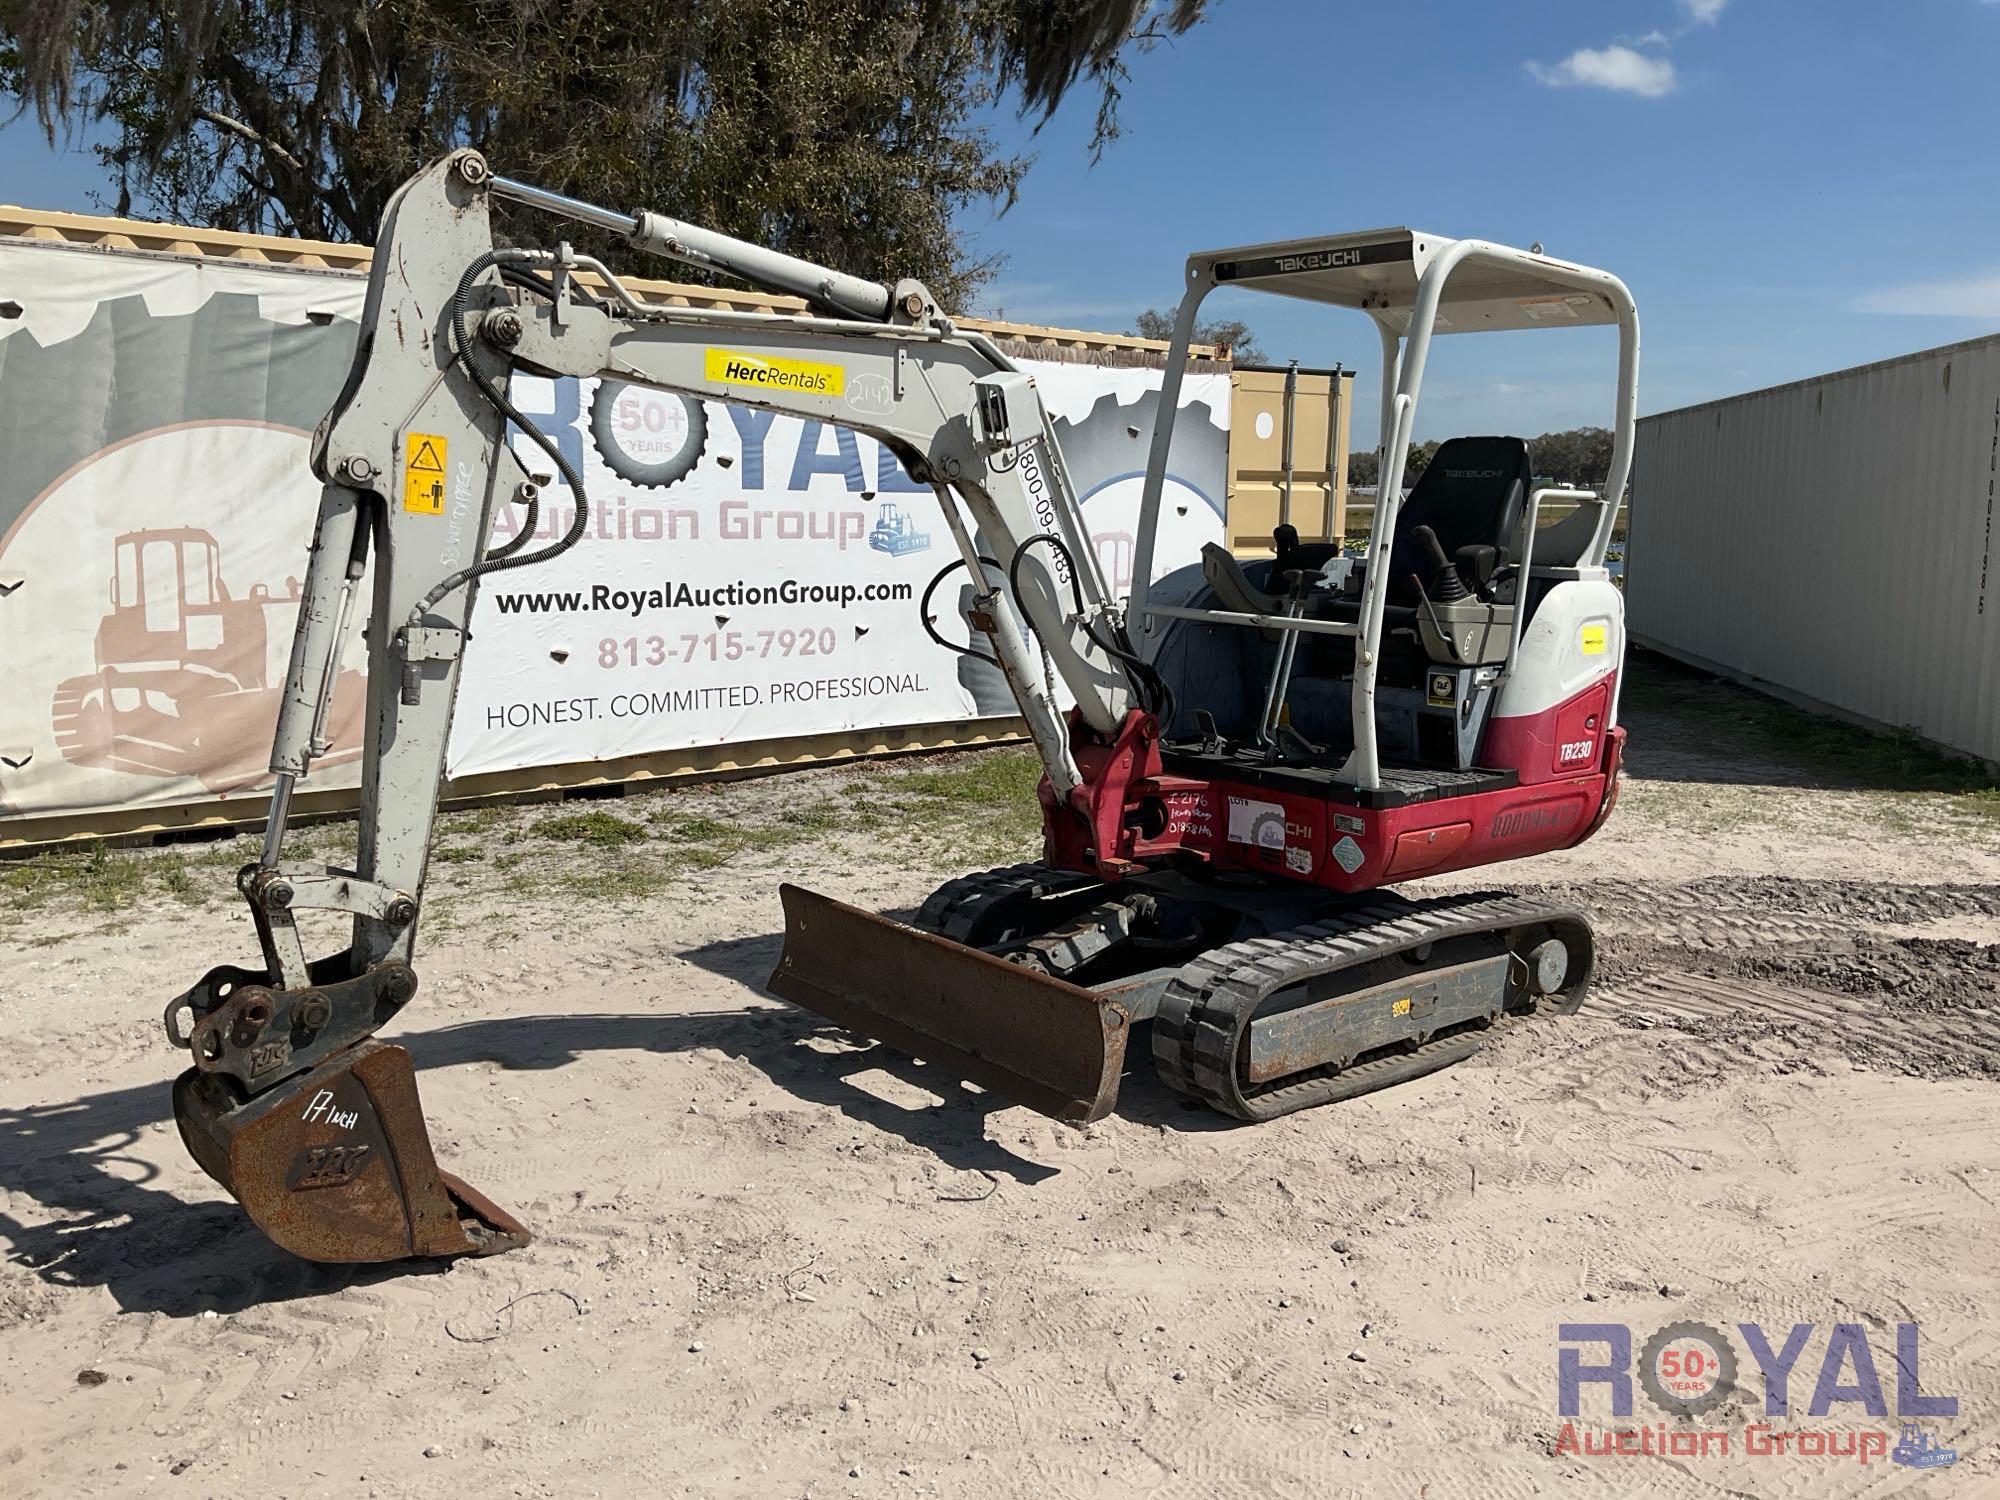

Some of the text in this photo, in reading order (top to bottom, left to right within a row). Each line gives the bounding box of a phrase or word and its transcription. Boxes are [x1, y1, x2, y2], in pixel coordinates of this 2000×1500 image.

[629, 439, 673, 453] YEARS
[719, 500, 865, 550] Group
[495, 580, 913, 618] www.RoyalAuctionGroup.com
[598, 626, 836, 669] 813-715-7920
[487, 673, 929, 729] HONEST. COMMITTED. PROFESSIONAL.
[1560, 740, 1592, 761] TB230
[302, 1089, 358, 1130] 17 INCH
